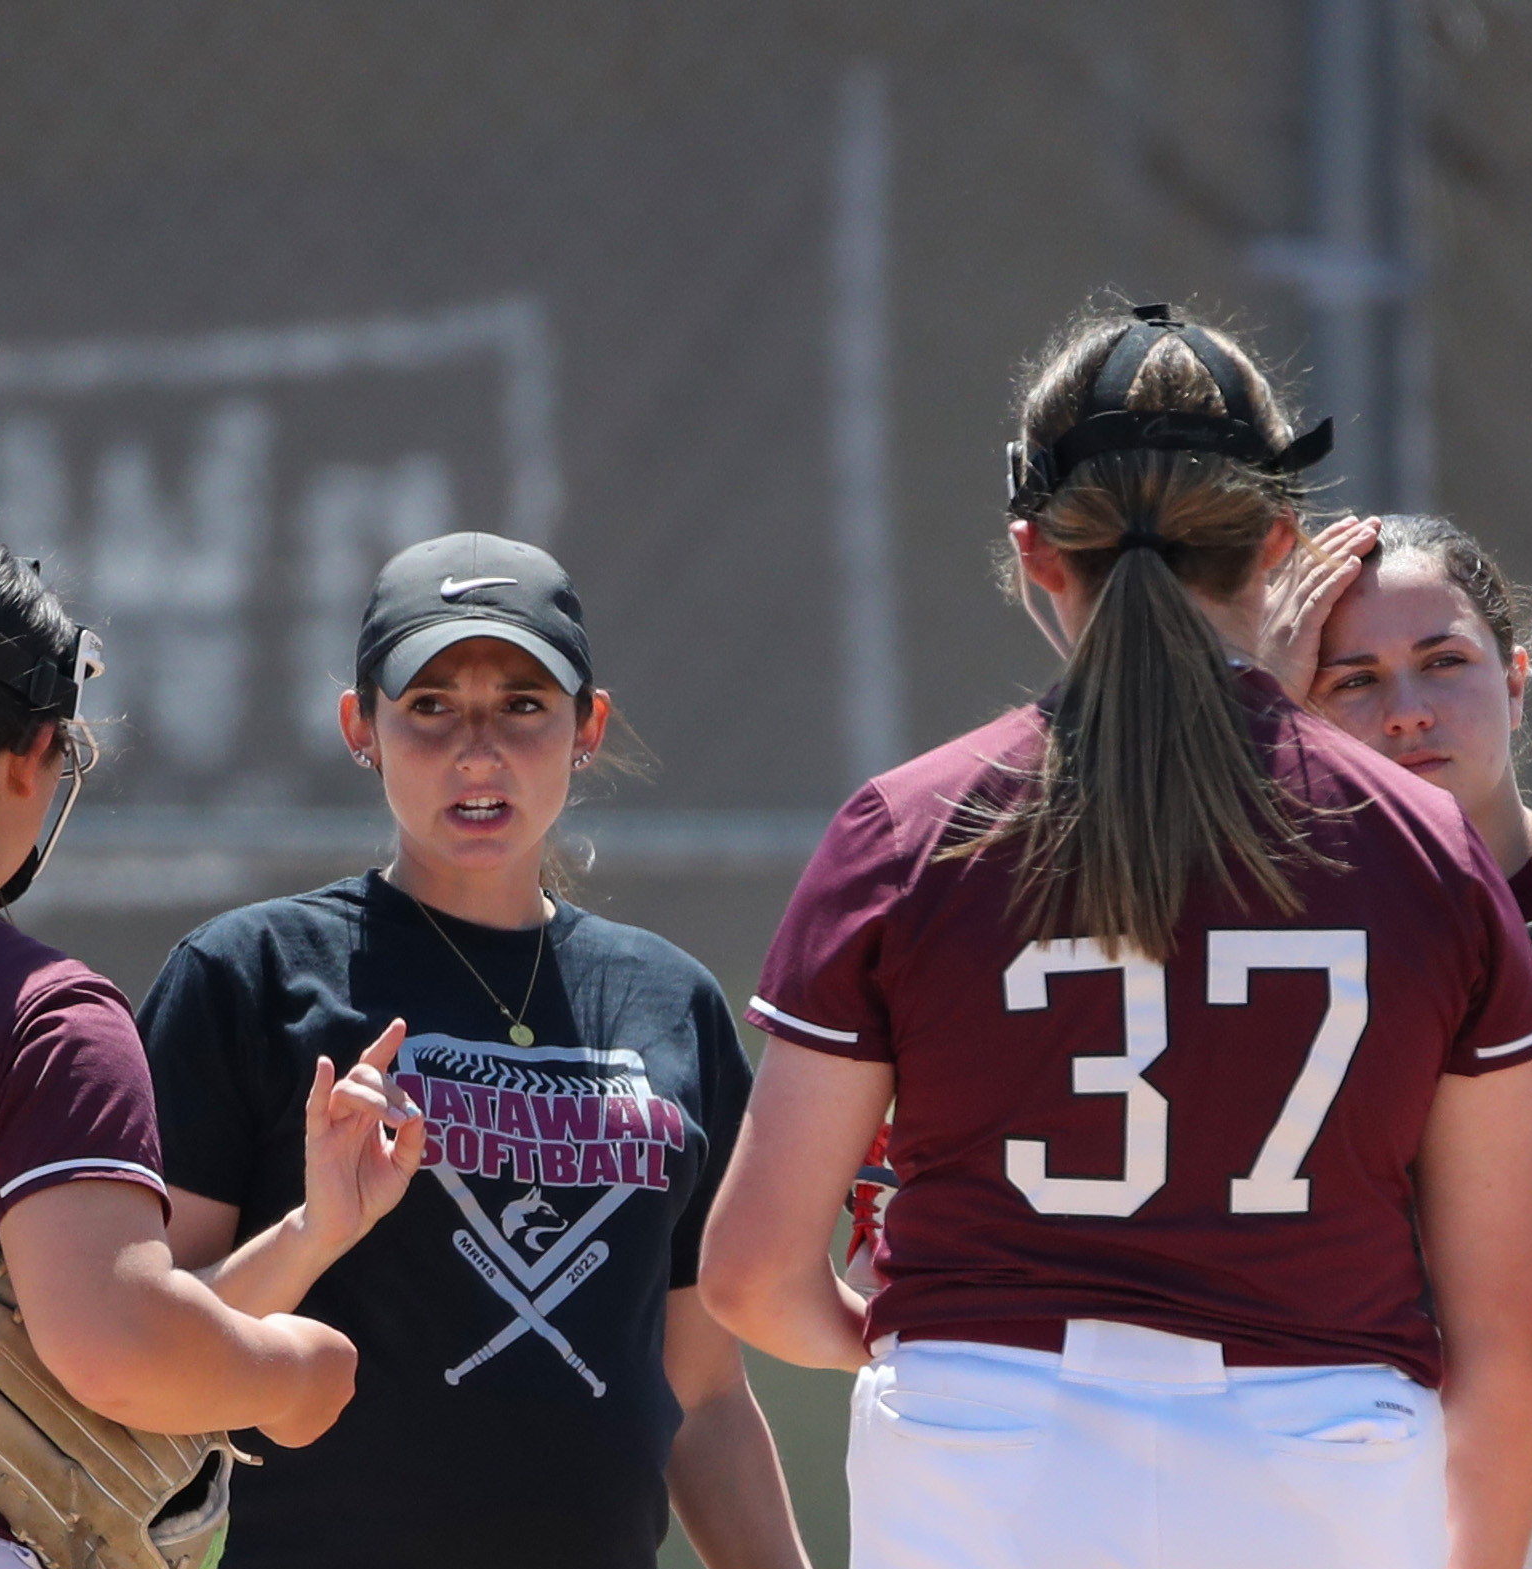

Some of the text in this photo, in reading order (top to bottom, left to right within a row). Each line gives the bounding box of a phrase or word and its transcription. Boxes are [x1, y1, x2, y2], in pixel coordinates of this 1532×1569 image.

[1003, 928, 1368, 1216] 37
[419, 1119, 669, 1191] SOFTBALL
[457, 1236, 497, 1281] MRHS
[565, 1251, 600, 1285] 2023
